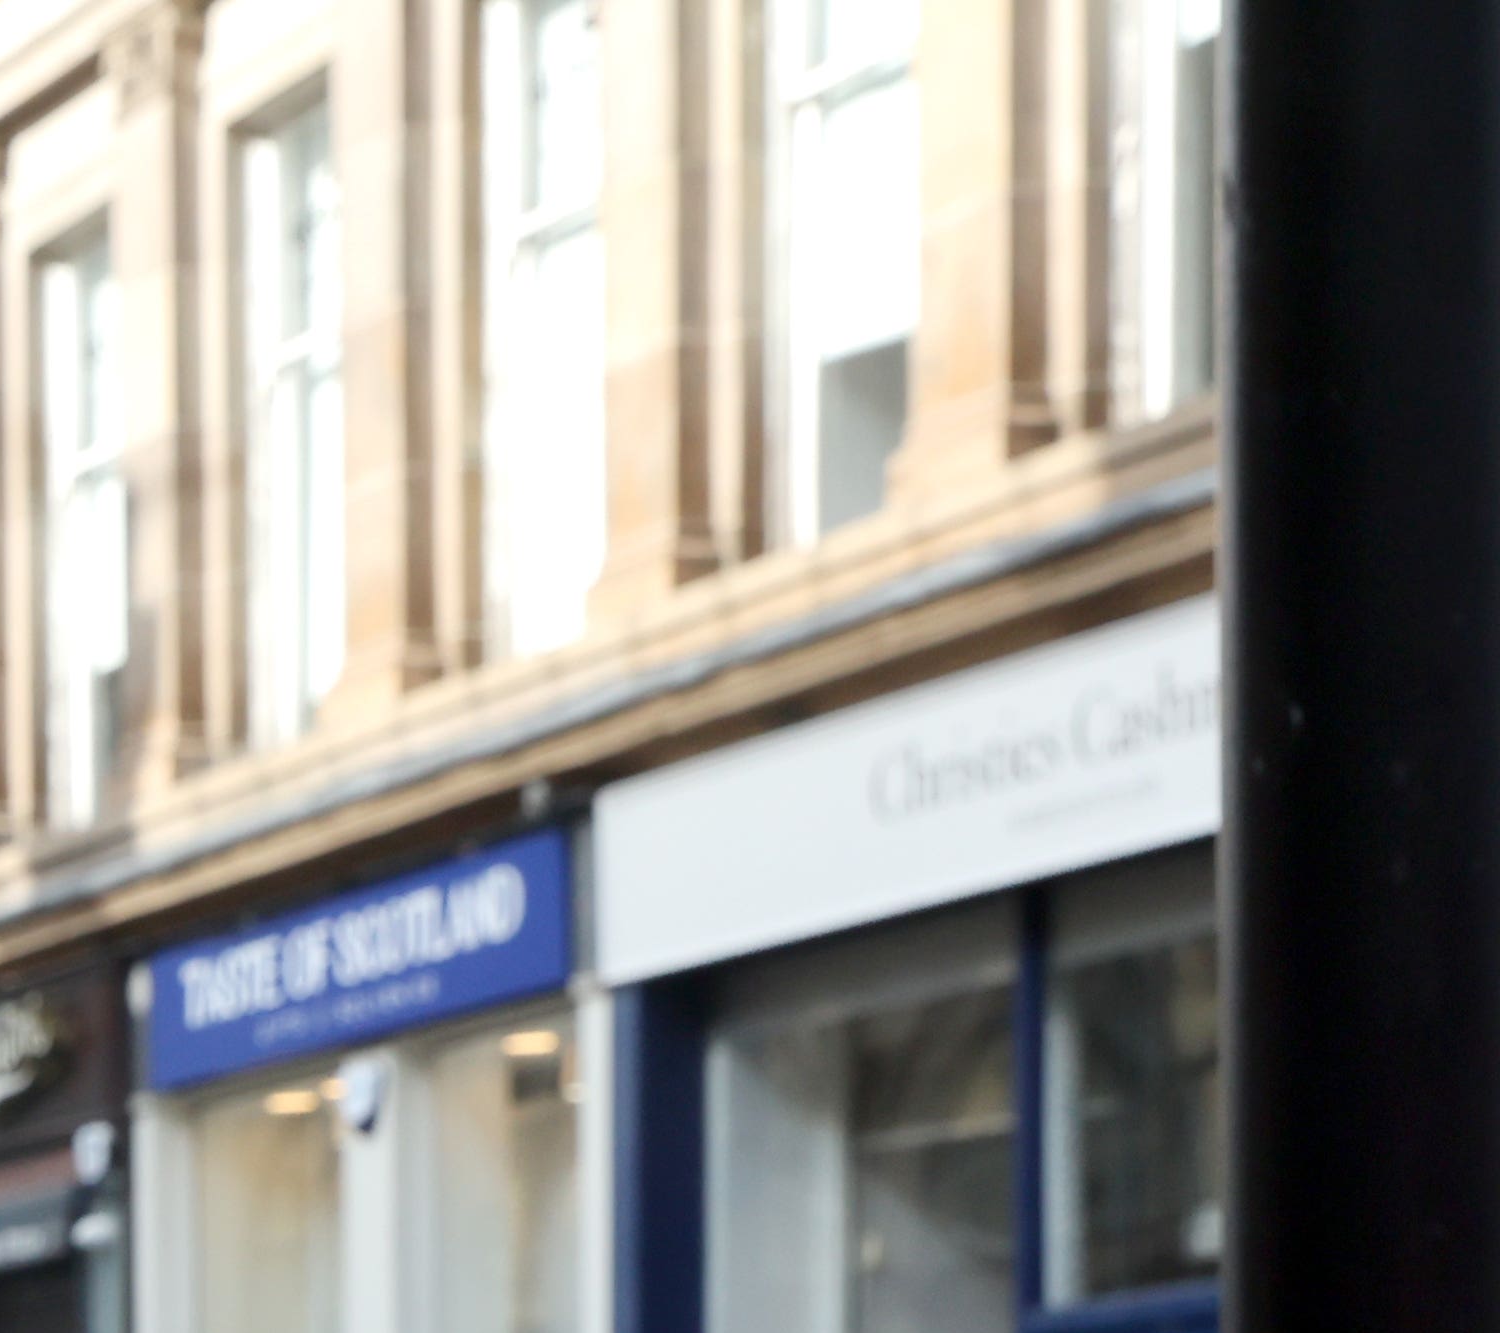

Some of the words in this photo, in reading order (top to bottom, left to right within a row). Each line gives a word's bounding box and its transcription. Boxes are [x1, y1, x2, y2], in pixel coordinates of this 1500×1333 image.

[177, 933, 283, 1030] TASTE
[281, 917, 332, 1001] OF
[330, 862, 527, 987] SCOTLAND
